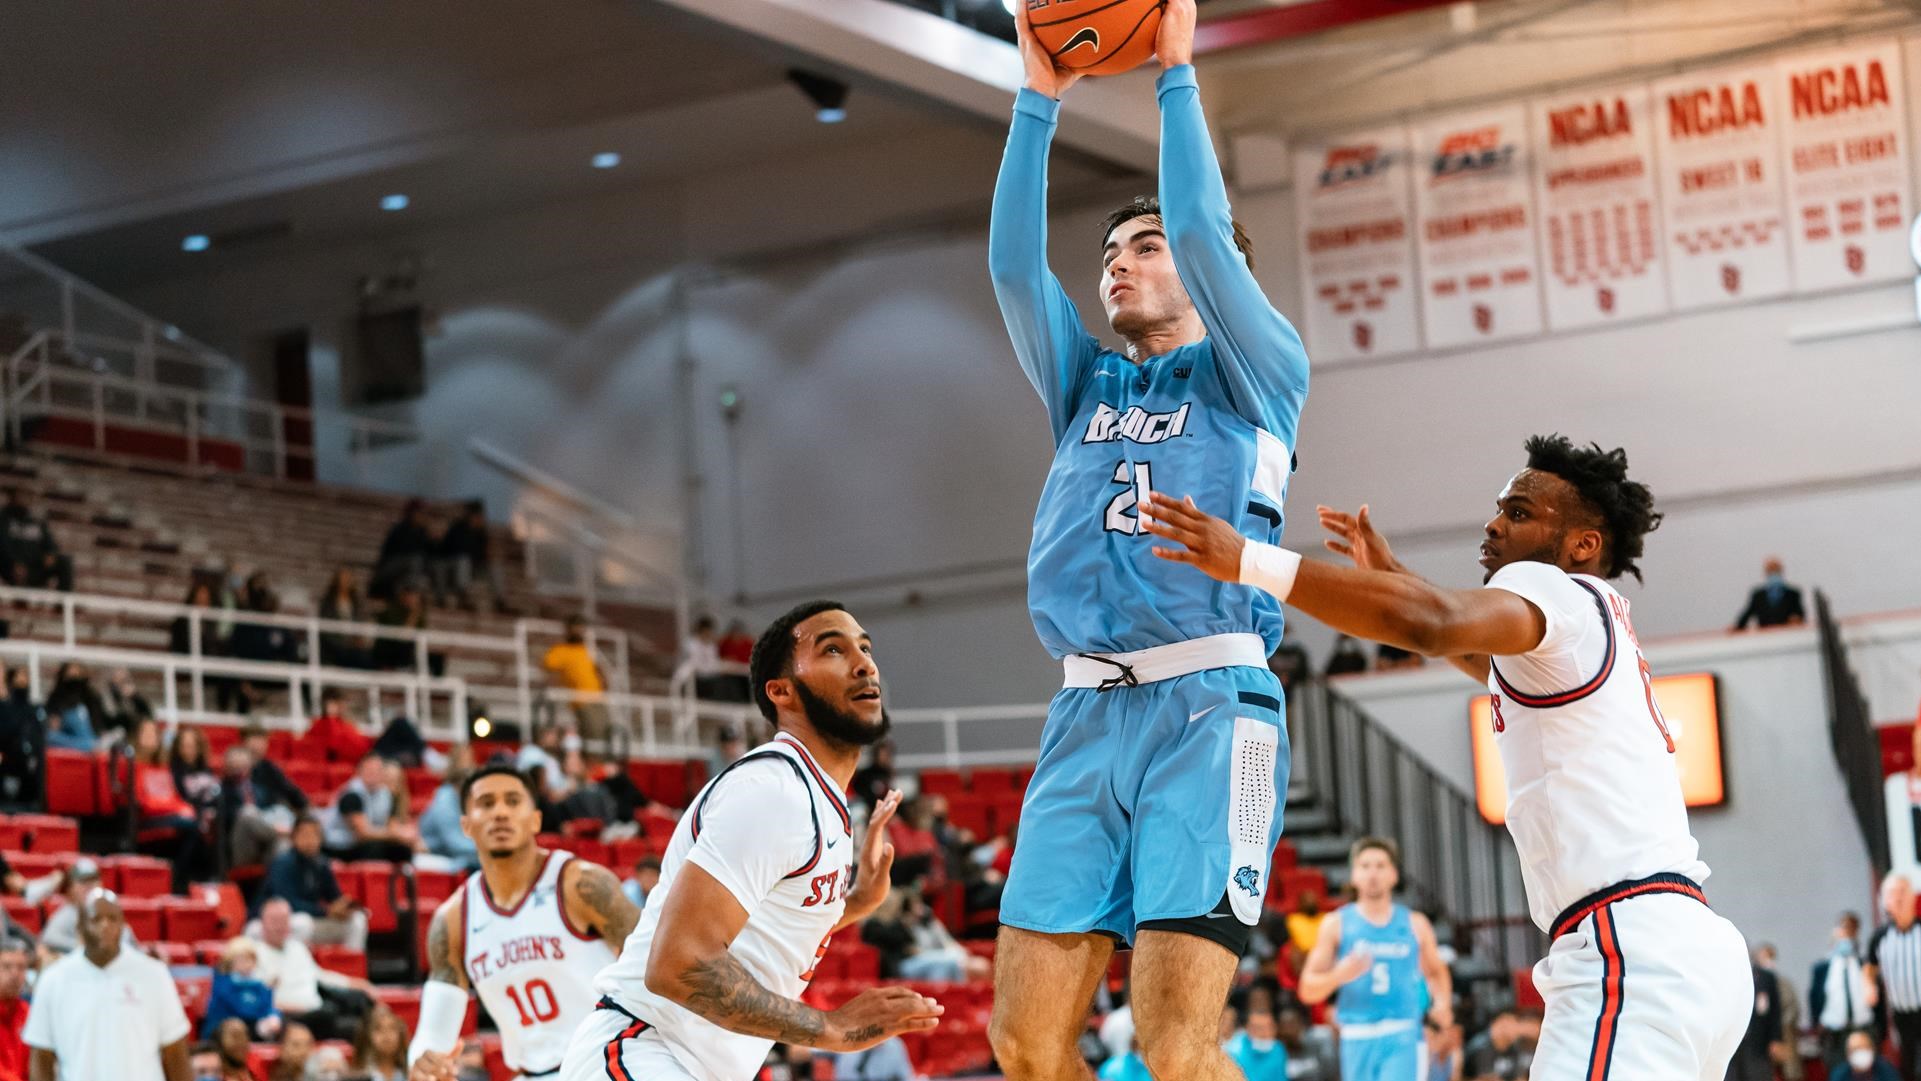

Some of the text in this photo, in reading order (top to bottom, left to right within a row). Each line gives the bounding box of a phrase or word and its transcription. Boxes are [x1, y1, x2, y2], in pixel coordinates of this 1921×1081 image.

[1667, 80, 1765, 140] NCAA
[1789, 59, 1889, 121] NCAA
[1548, 97, 1632, 148] NCAA
[1103, 459, 1156, 537] 21
[496, 936, 564, 969] JOHN'S
[505, 977, 560, 1028] 10
